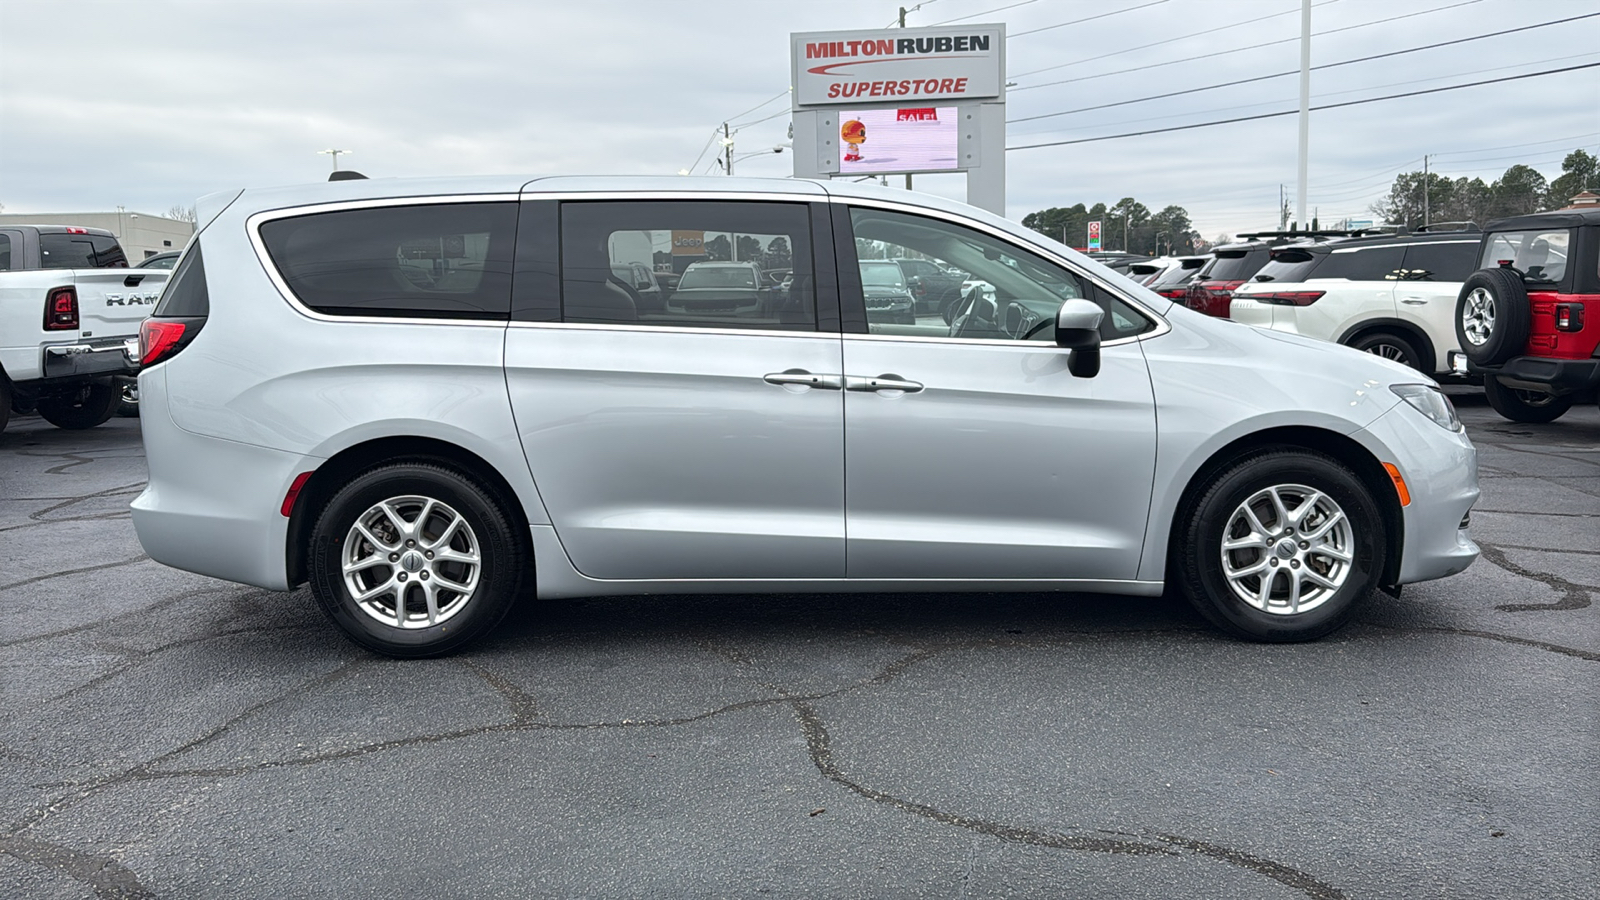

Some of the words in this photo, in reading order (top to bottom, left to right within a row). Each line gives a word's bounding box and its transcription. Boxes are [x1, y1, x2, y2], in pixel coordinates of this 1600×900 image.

[805, 38, 894, 59] MILTON
[896, 34, 990, 54] RUBEN
[827, 77, 968, 98] SUPERSTORE
[674, 236, 702, 248] Jeep
[105, 292, 159, 306] RAM
